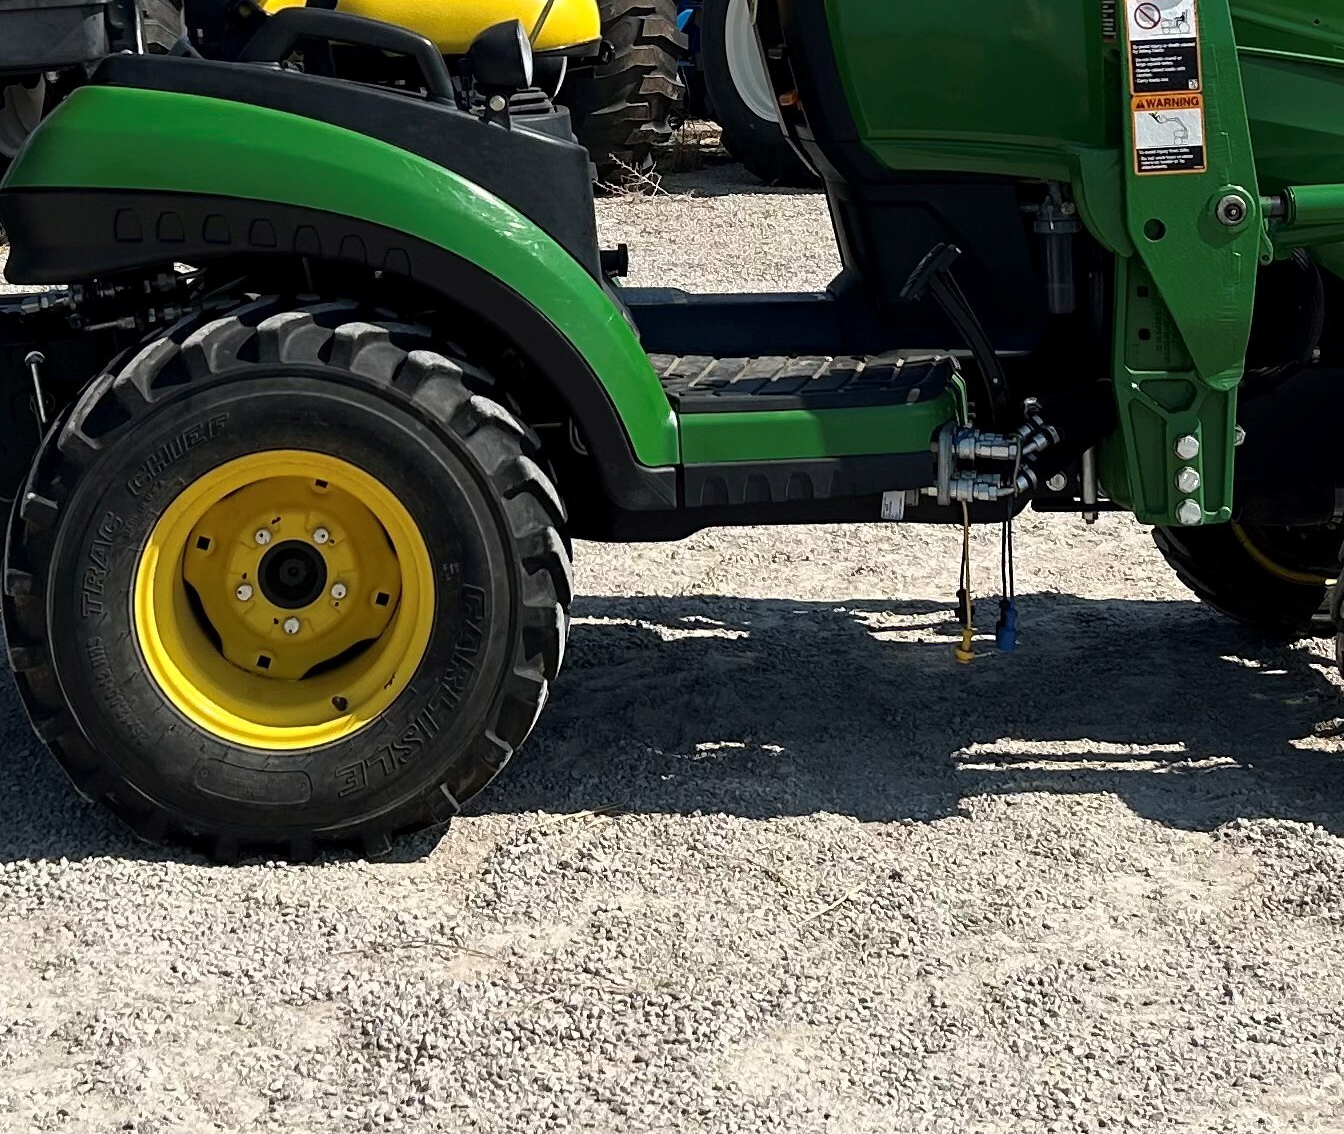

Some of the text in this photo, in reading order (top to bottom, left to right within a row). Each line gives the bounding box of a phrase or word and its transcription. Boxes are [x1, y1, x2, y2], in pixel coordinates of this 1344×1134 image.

[1145, 96, 1200, 108] WARNING
[81, 511, 123, 619] TRAC
[127, 413, 230, 497] CHIEF
[335, 583, 486, 798] CARLISLE
